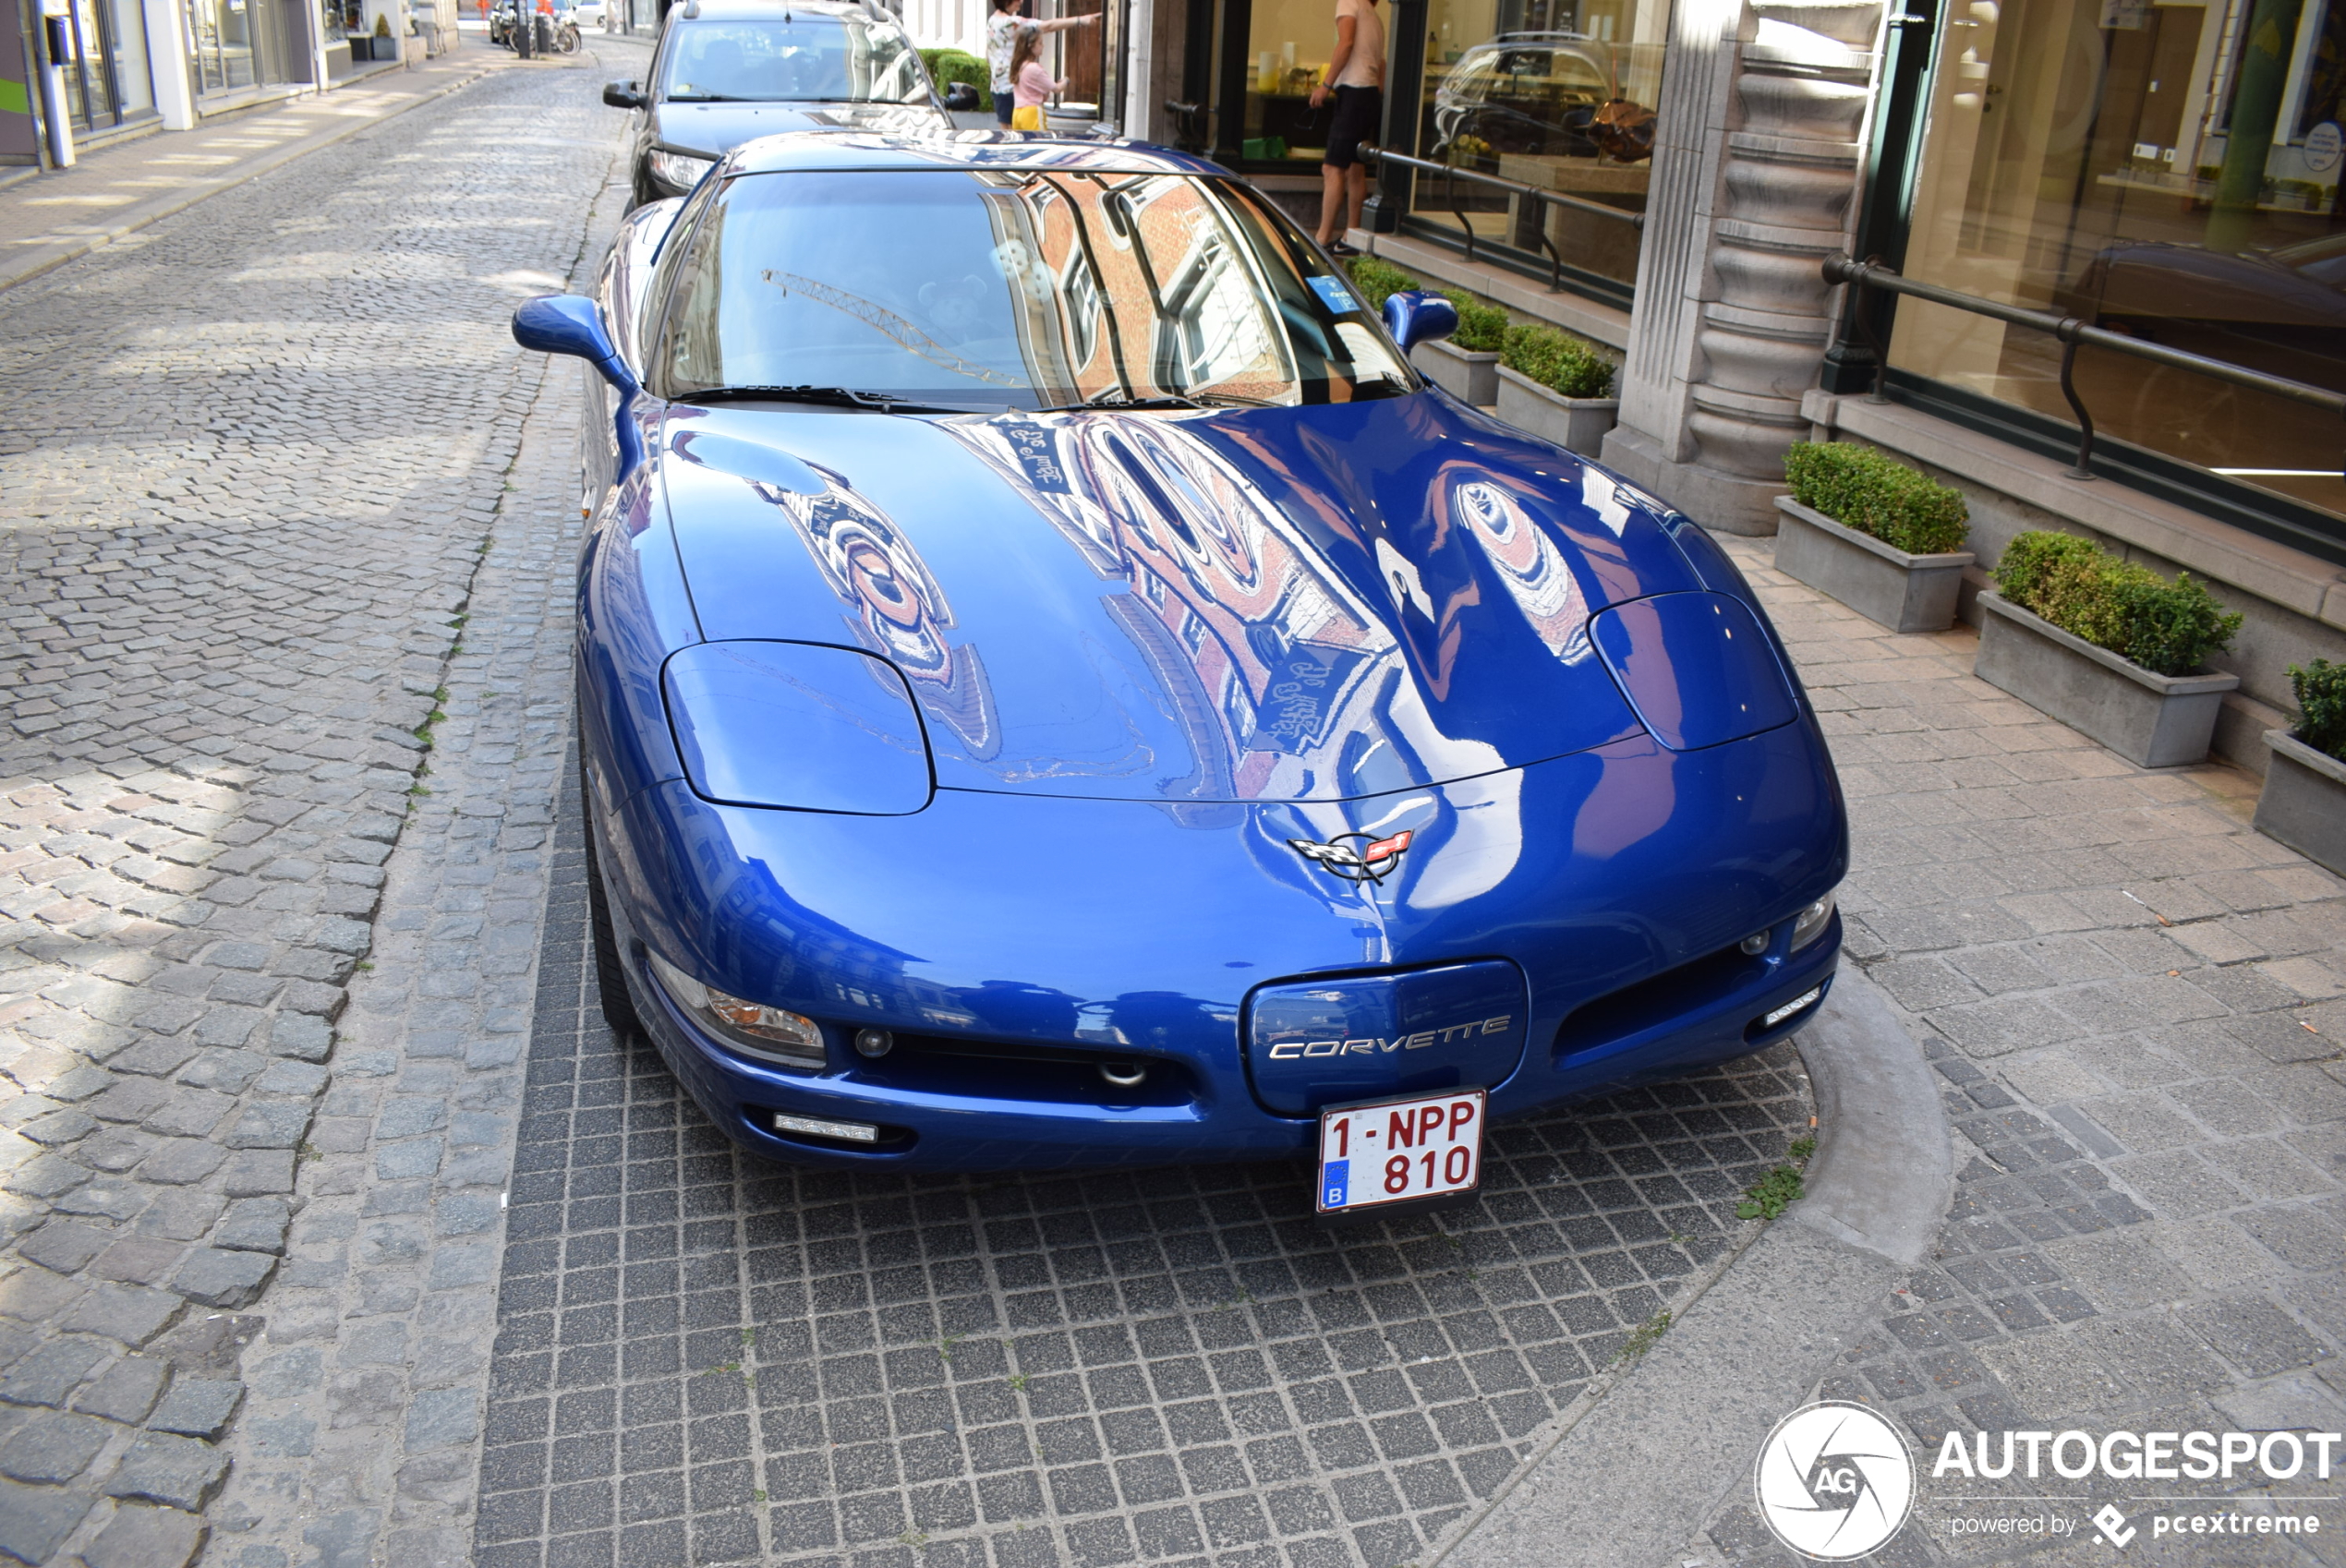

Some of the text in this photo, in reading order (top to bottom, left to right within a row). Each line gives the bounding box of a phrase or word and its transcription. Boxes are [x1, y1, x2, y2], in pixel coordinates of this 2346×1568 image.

[1269, 1015, 1511, 1058] CORVETTE
[1384, 1145, 1470, 1195] 810
[1328, 1188, 1343, 1204] B
